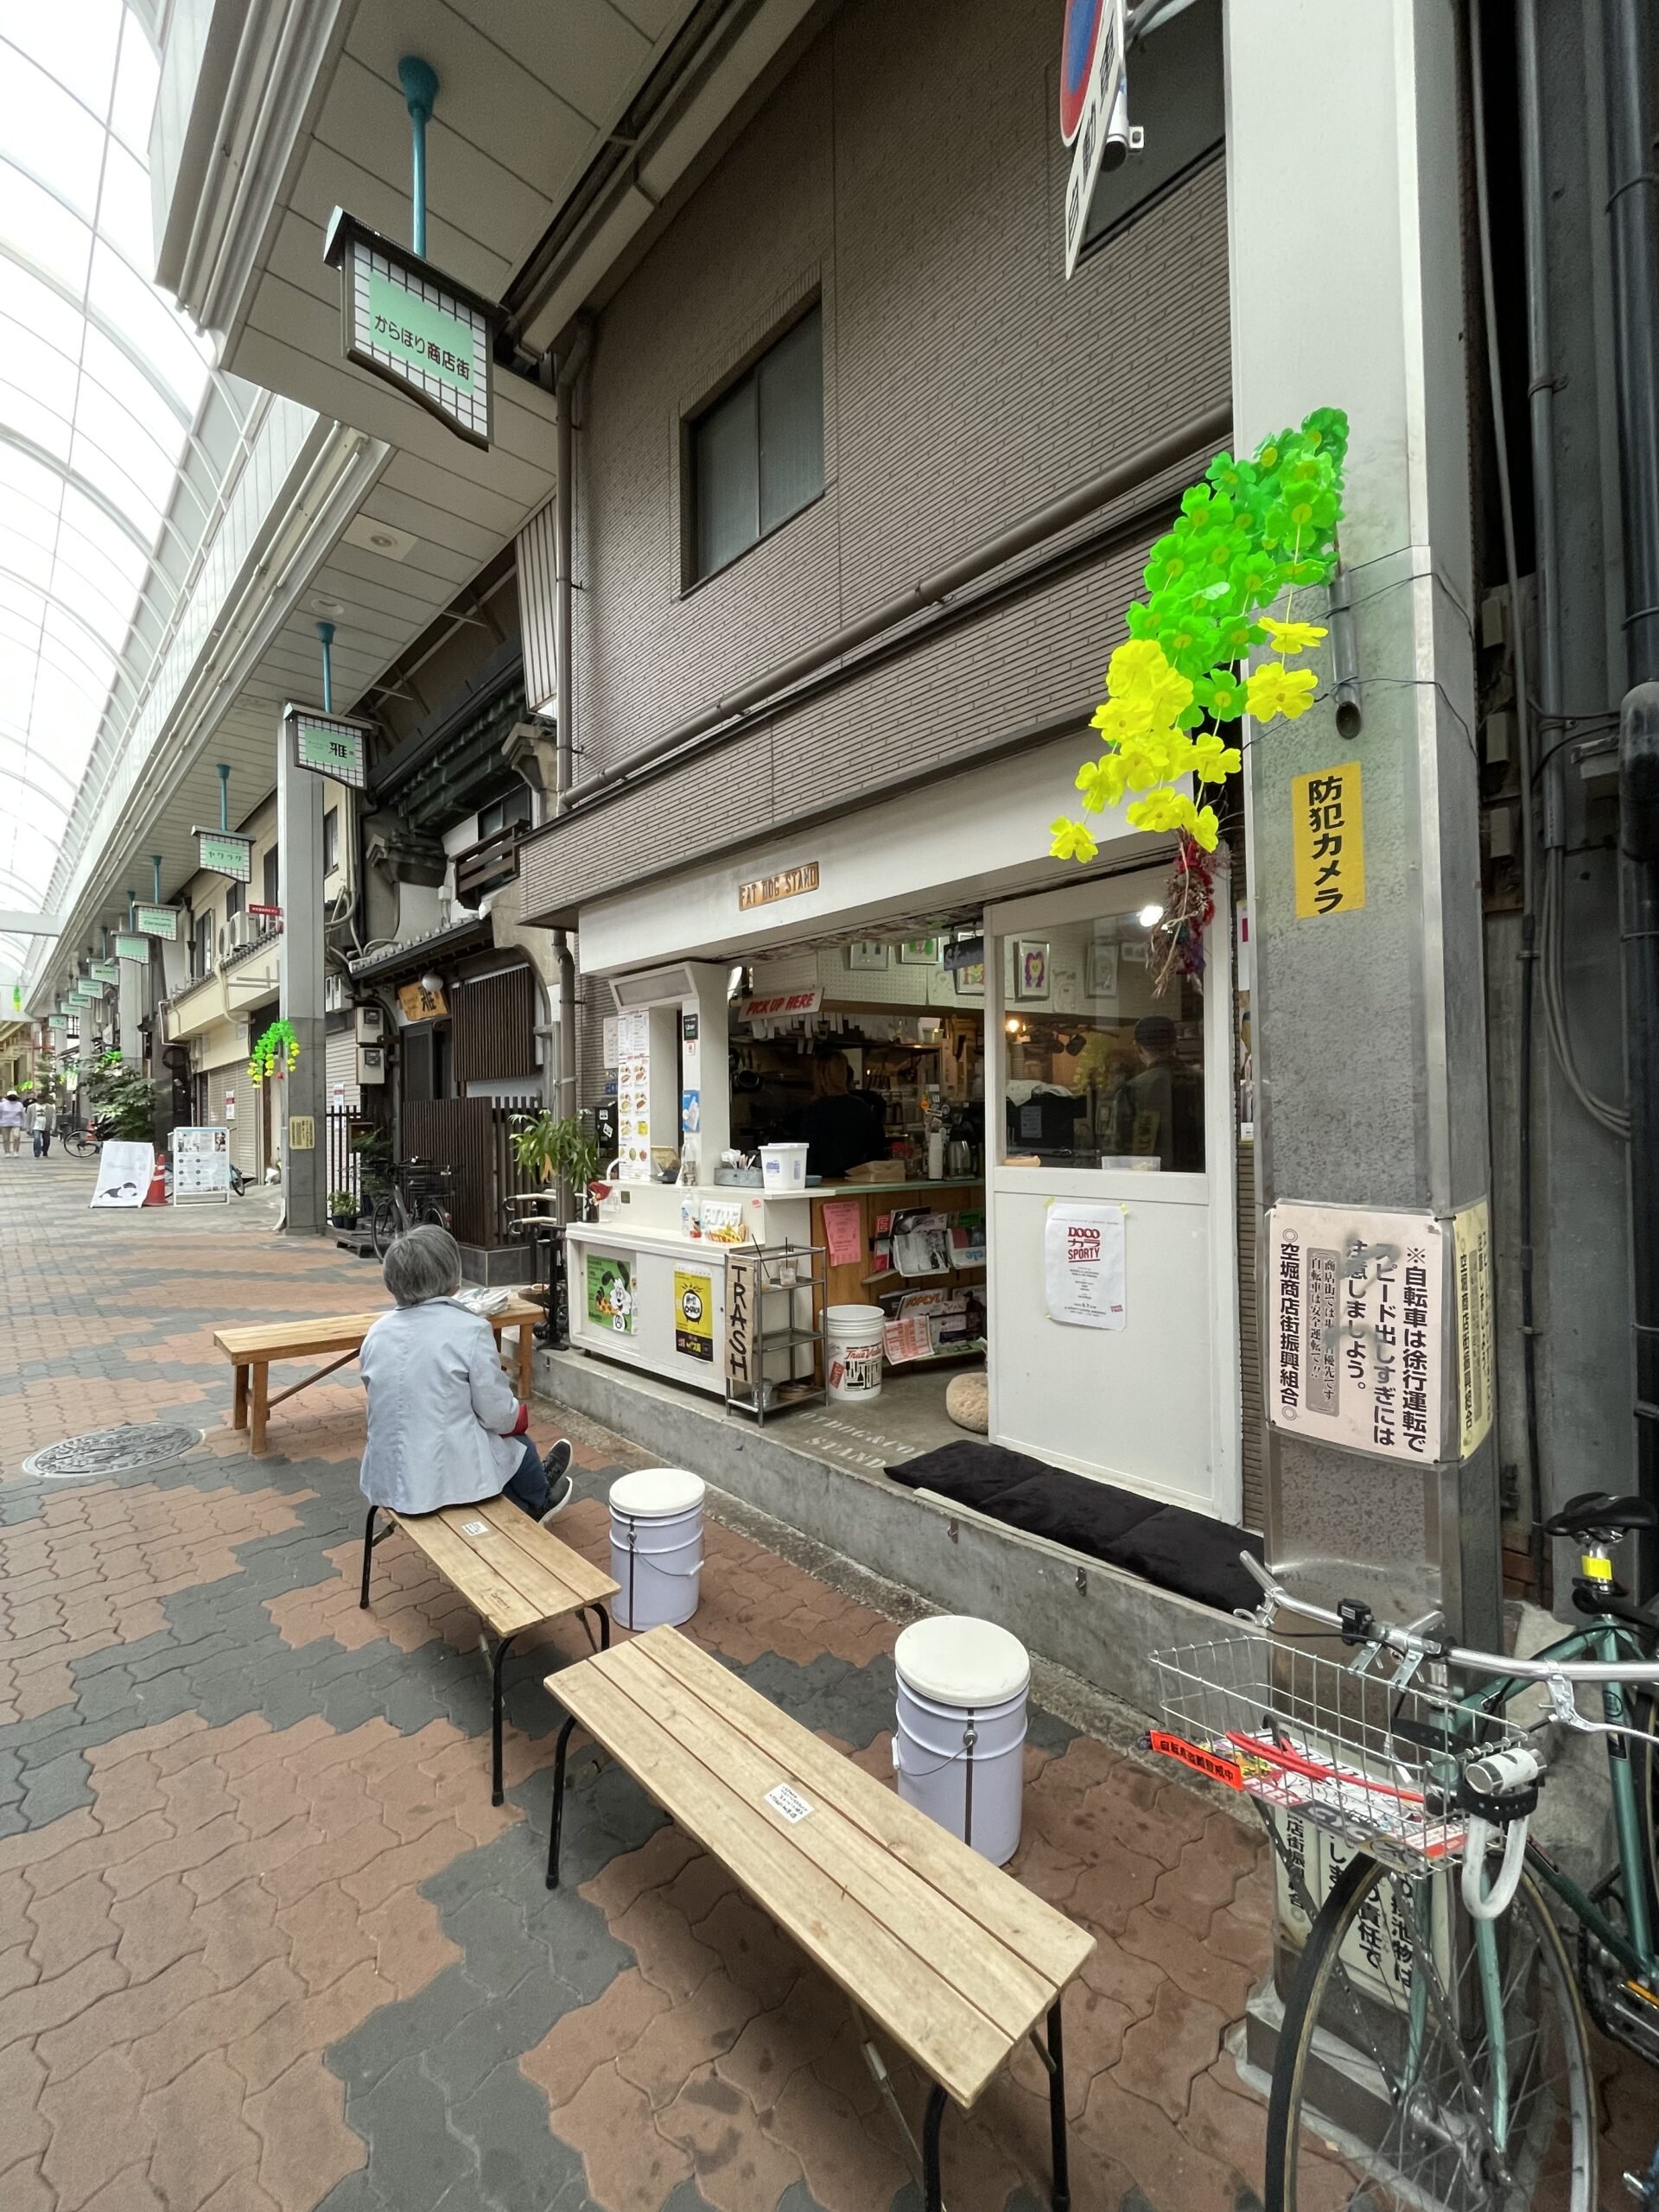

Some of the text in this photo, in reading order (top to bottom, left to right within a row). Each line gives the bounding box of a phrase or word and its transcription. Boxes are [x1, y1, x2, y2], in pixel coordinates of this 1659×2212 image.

[374, 315, 470, 380] からほり商店街
[328, 741, 347, 759] 雅
[1308, 775, 1345, 914] 防犯カメラ
[762, 876, 780, 900] DOG
[785, 866, 817, 893] STAND
[746, 992, 816, 1016] PICK UP HERE
[1068, 1247, 1100, 1260] SPORTY
[729, 1265, 747, 1382] TRASH
[804, 1437, 887, 1468] STAND
